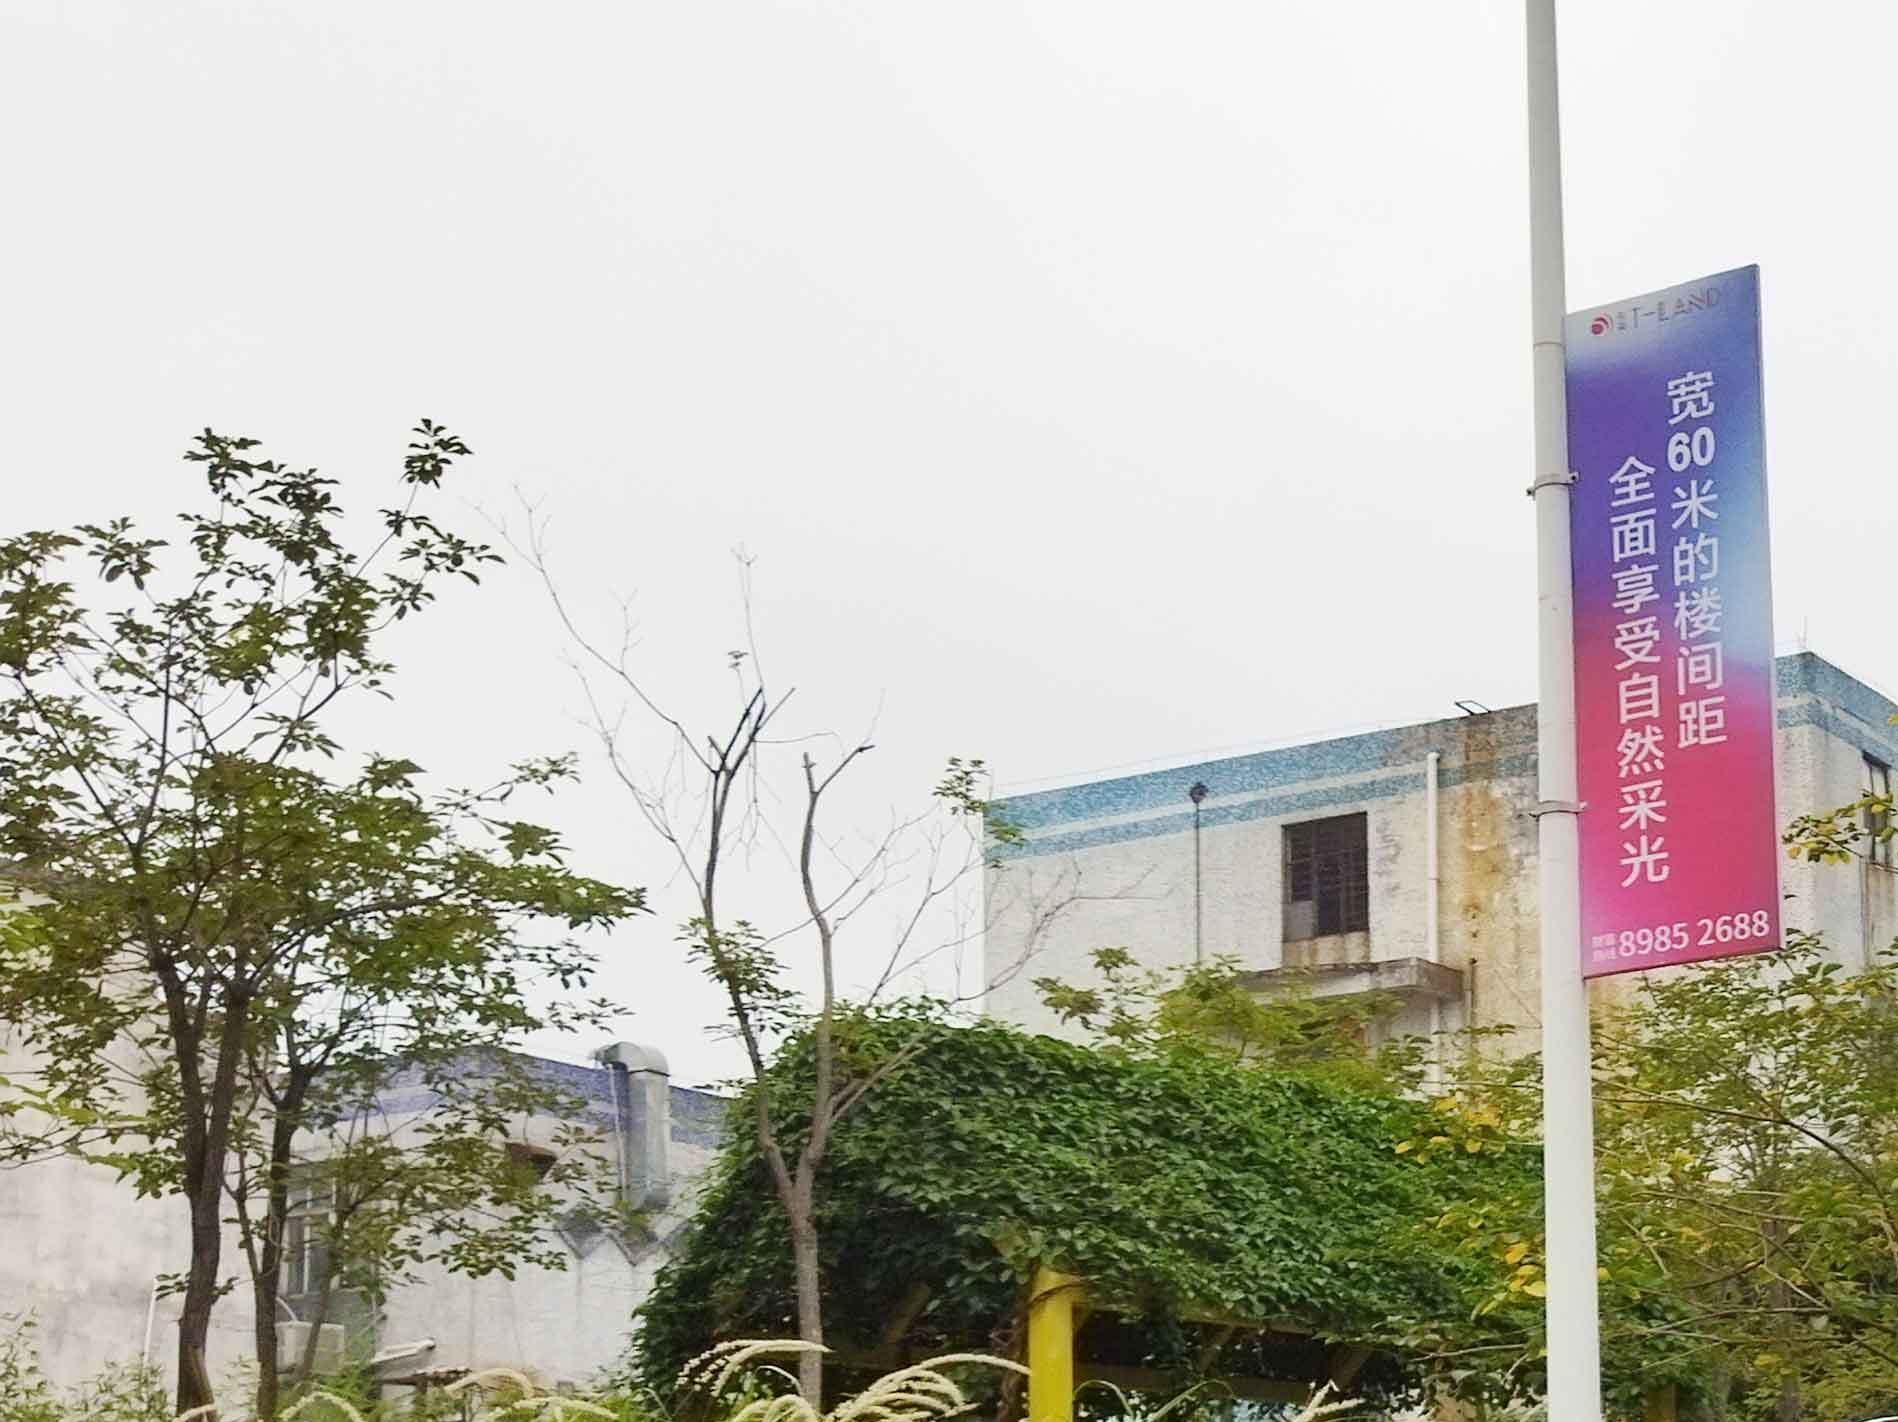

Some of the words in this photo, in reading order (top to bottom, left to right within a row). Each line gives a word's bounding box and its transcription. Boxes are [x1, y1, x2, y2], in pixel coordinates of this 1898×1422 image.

[1608, 456, 1670, 887] 全面享受自然采光
[1666, 371, 1729, 749] 宽60米的楼间距
[1618, 922, 1690, 957] 8985
[1696, 910, 1770, 946] 2688
